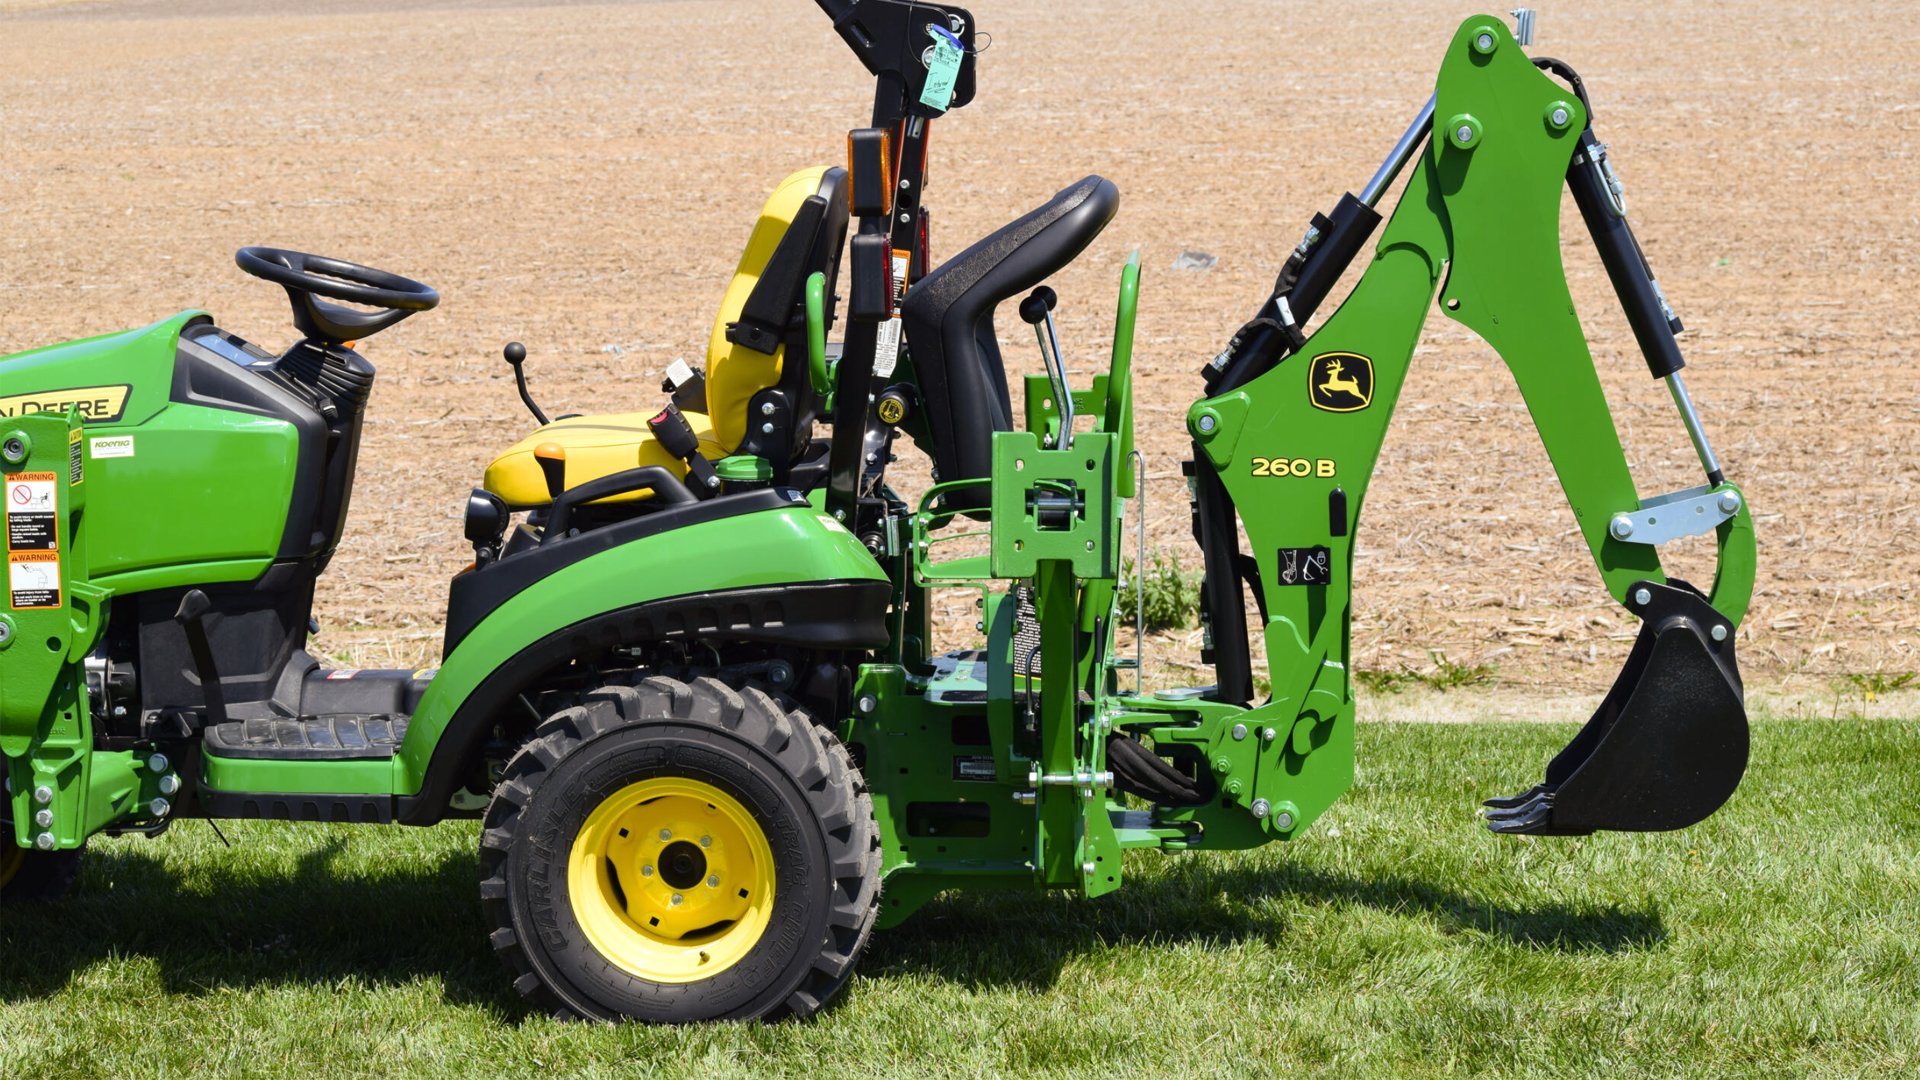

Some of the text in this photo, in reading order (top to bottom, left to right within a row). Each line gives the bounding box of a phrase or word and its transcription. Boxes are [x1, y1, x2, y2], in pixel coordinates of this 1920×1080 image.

[1251, 456, 1336, 478] 260 B
[15, 473, 54, 481] WARNING
[18, 553, 57, 561] WARNING
[526, 781, 584, 952] CARLISLE
